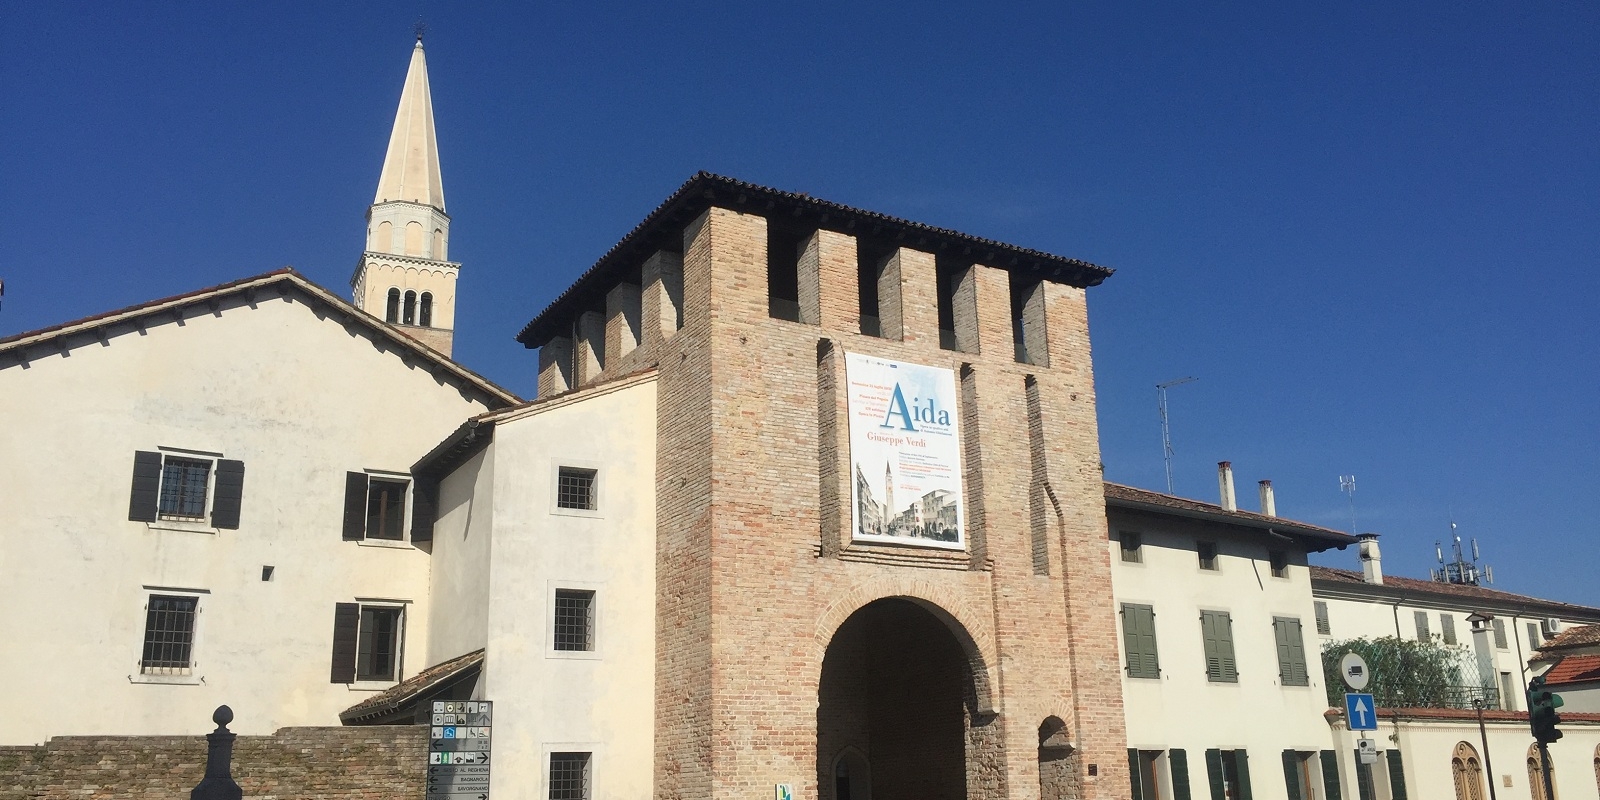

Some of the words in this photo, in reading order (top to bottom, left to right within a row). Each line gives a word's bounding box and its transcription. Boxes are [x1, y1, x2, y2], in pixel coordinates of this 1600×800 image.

[880, 382, 951, 432] Aida
[867, 431, 904, 447] Giuseppe
[906, 436, 926, 448] Verdi
